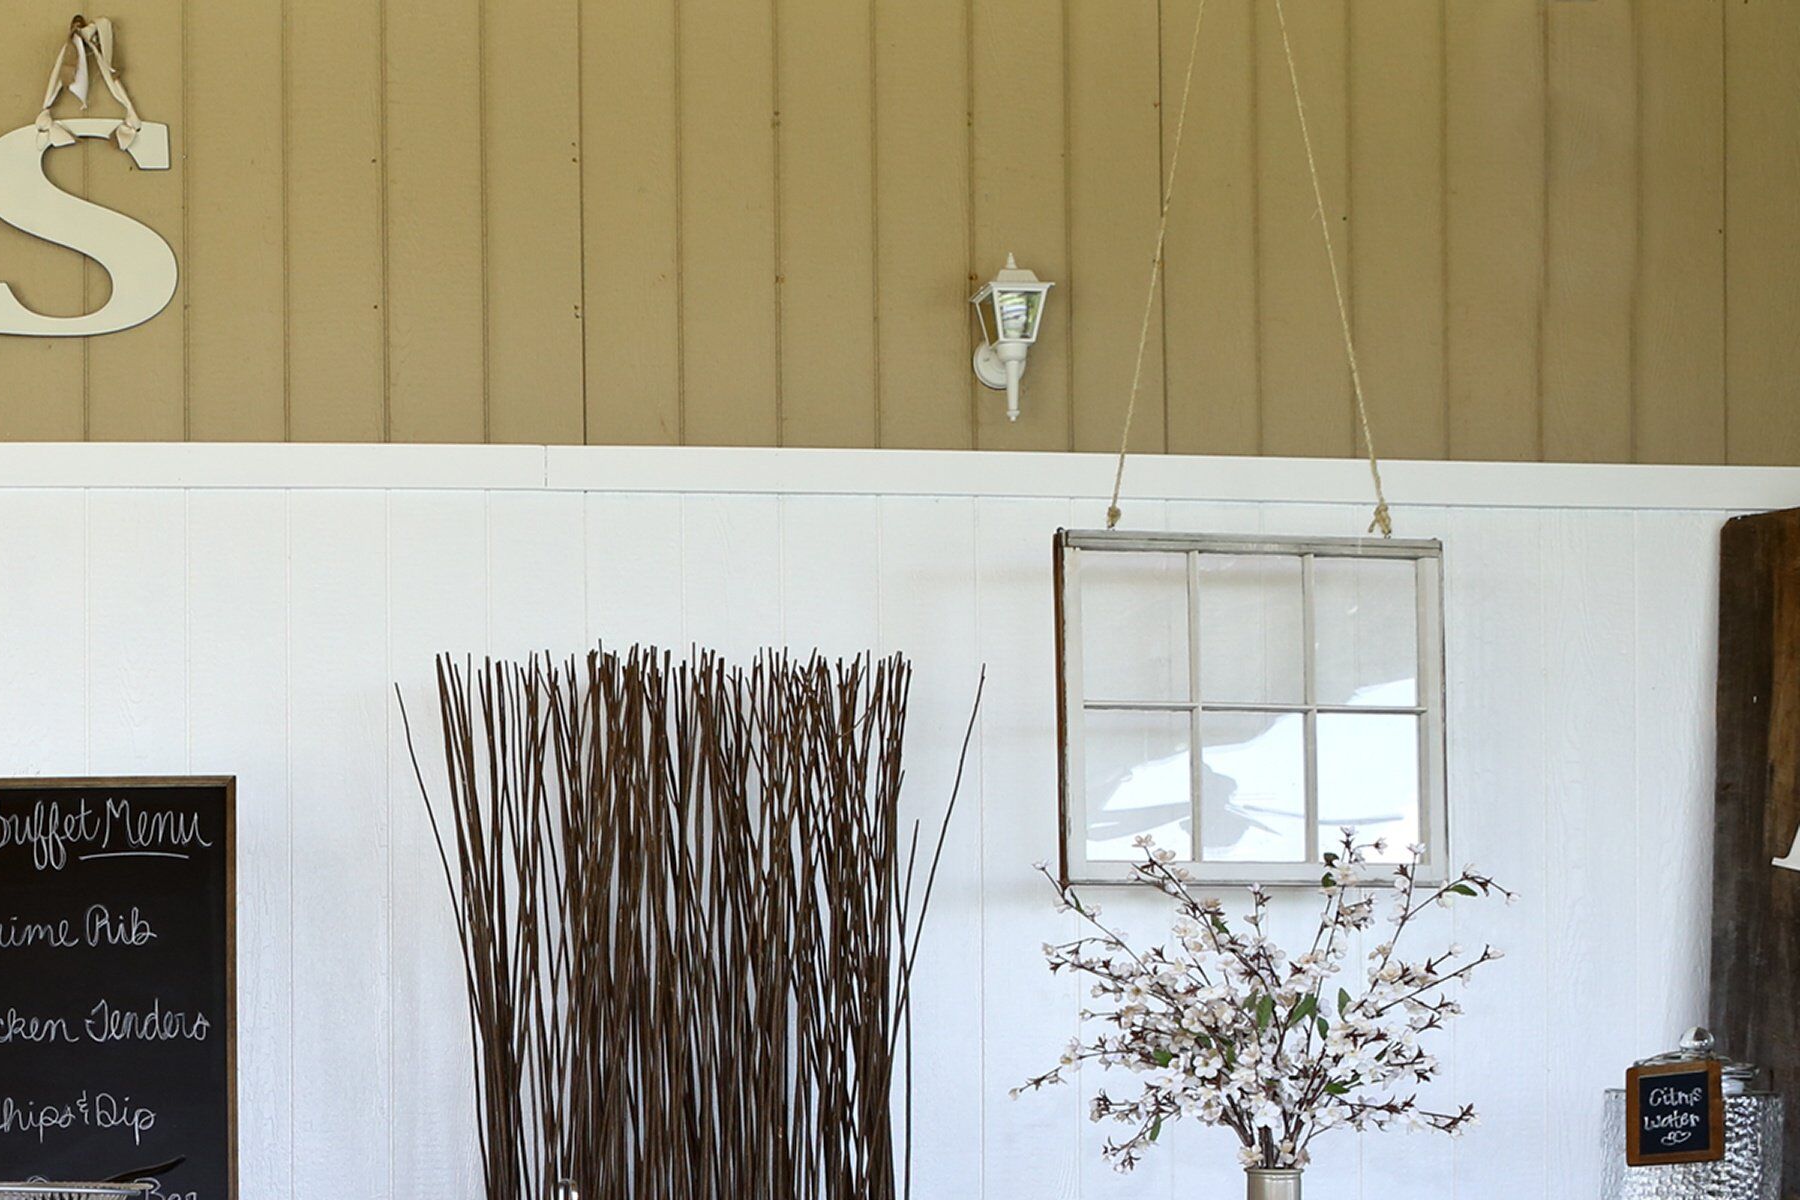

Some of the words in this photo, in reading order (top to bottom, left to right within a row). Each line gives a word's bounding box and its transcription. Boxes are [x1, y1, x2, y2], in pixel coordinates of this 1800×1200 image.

[102, 797, 213, 849] Menu
[86, 904, 157, 947] Rib
[85, 997, 211, 1042] Tenders
[95, 1092, 157, 1146] Dip
[1648, 1086, 1703, 1107] Citrus
